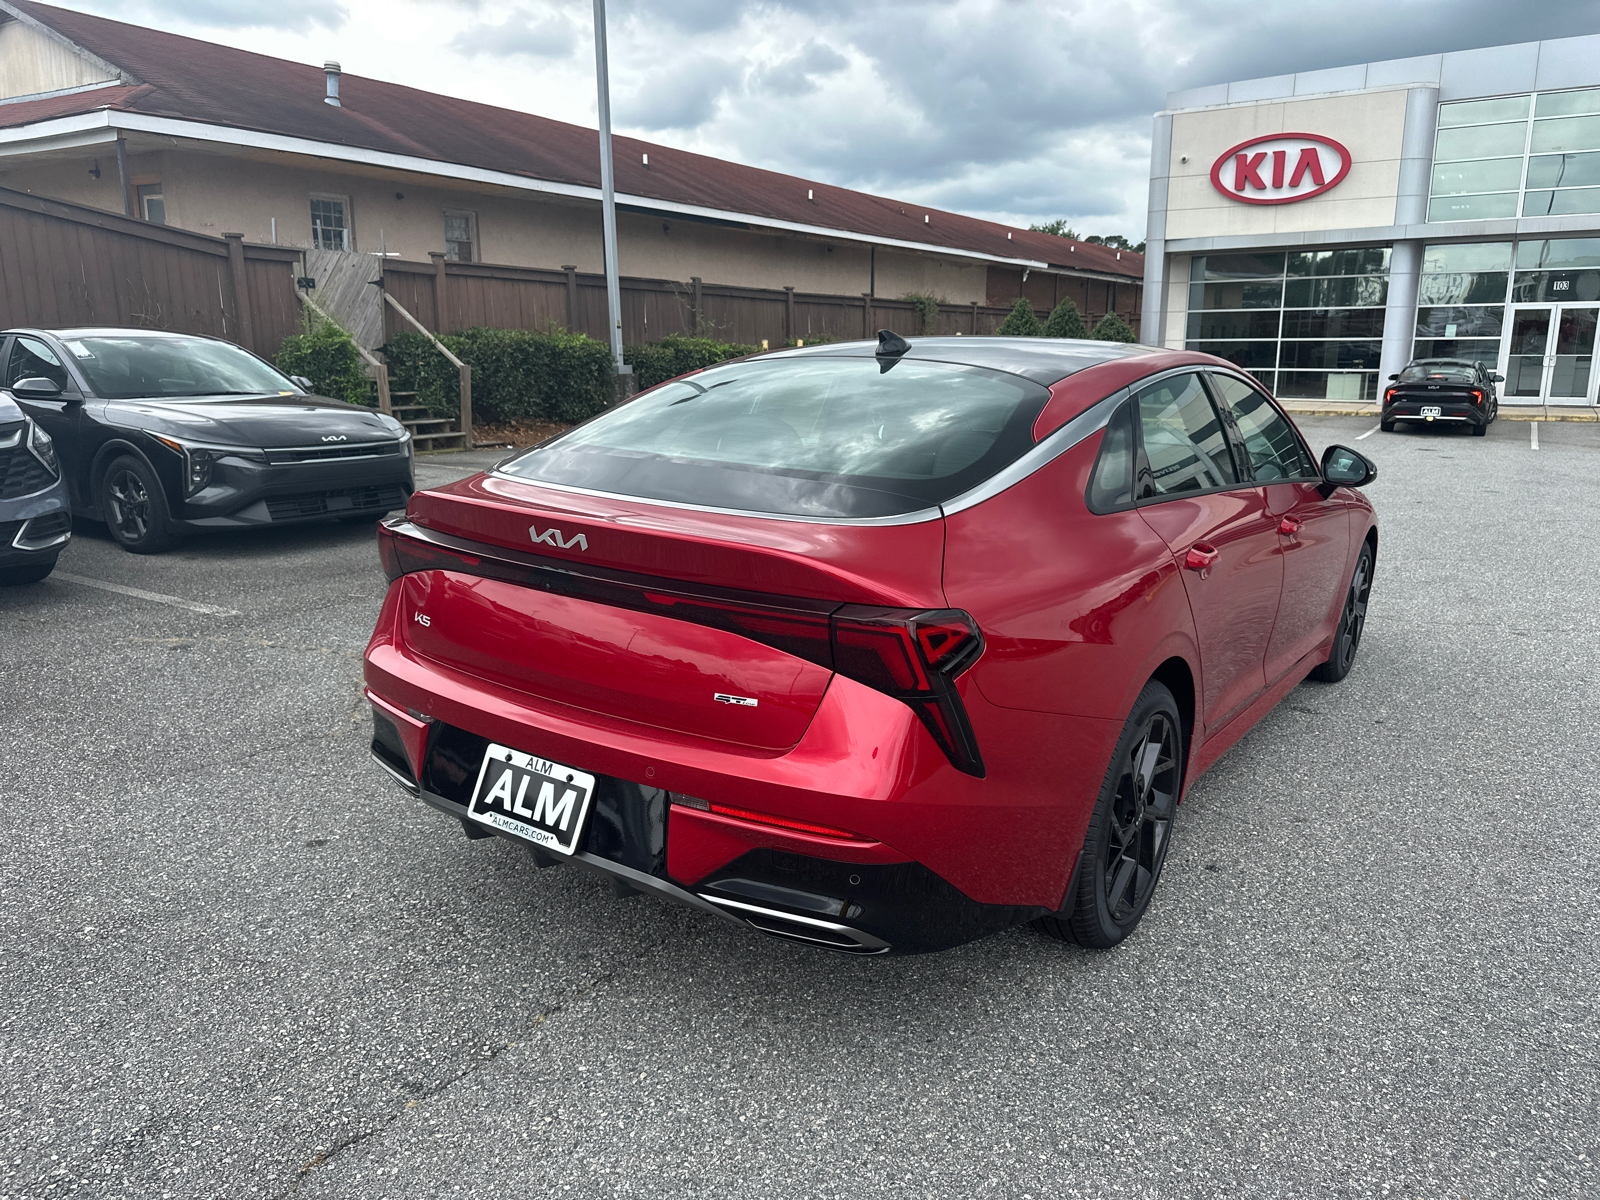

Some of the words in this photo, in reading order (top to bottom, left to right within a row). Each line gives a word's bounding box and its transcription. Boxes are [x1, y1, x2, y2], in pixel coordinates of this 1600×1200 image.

[1234, 147, 1326, 191] KIA
[1554, 281, 1570, 290] 103
[528, 524, 589, 552] KIA
[414, 610, 431, 627] K5
[525, 757, 553, 776] ALM
[483, 768, 578, 832] ALM
[491, 815, 550, 844] ALMCARS.COM
